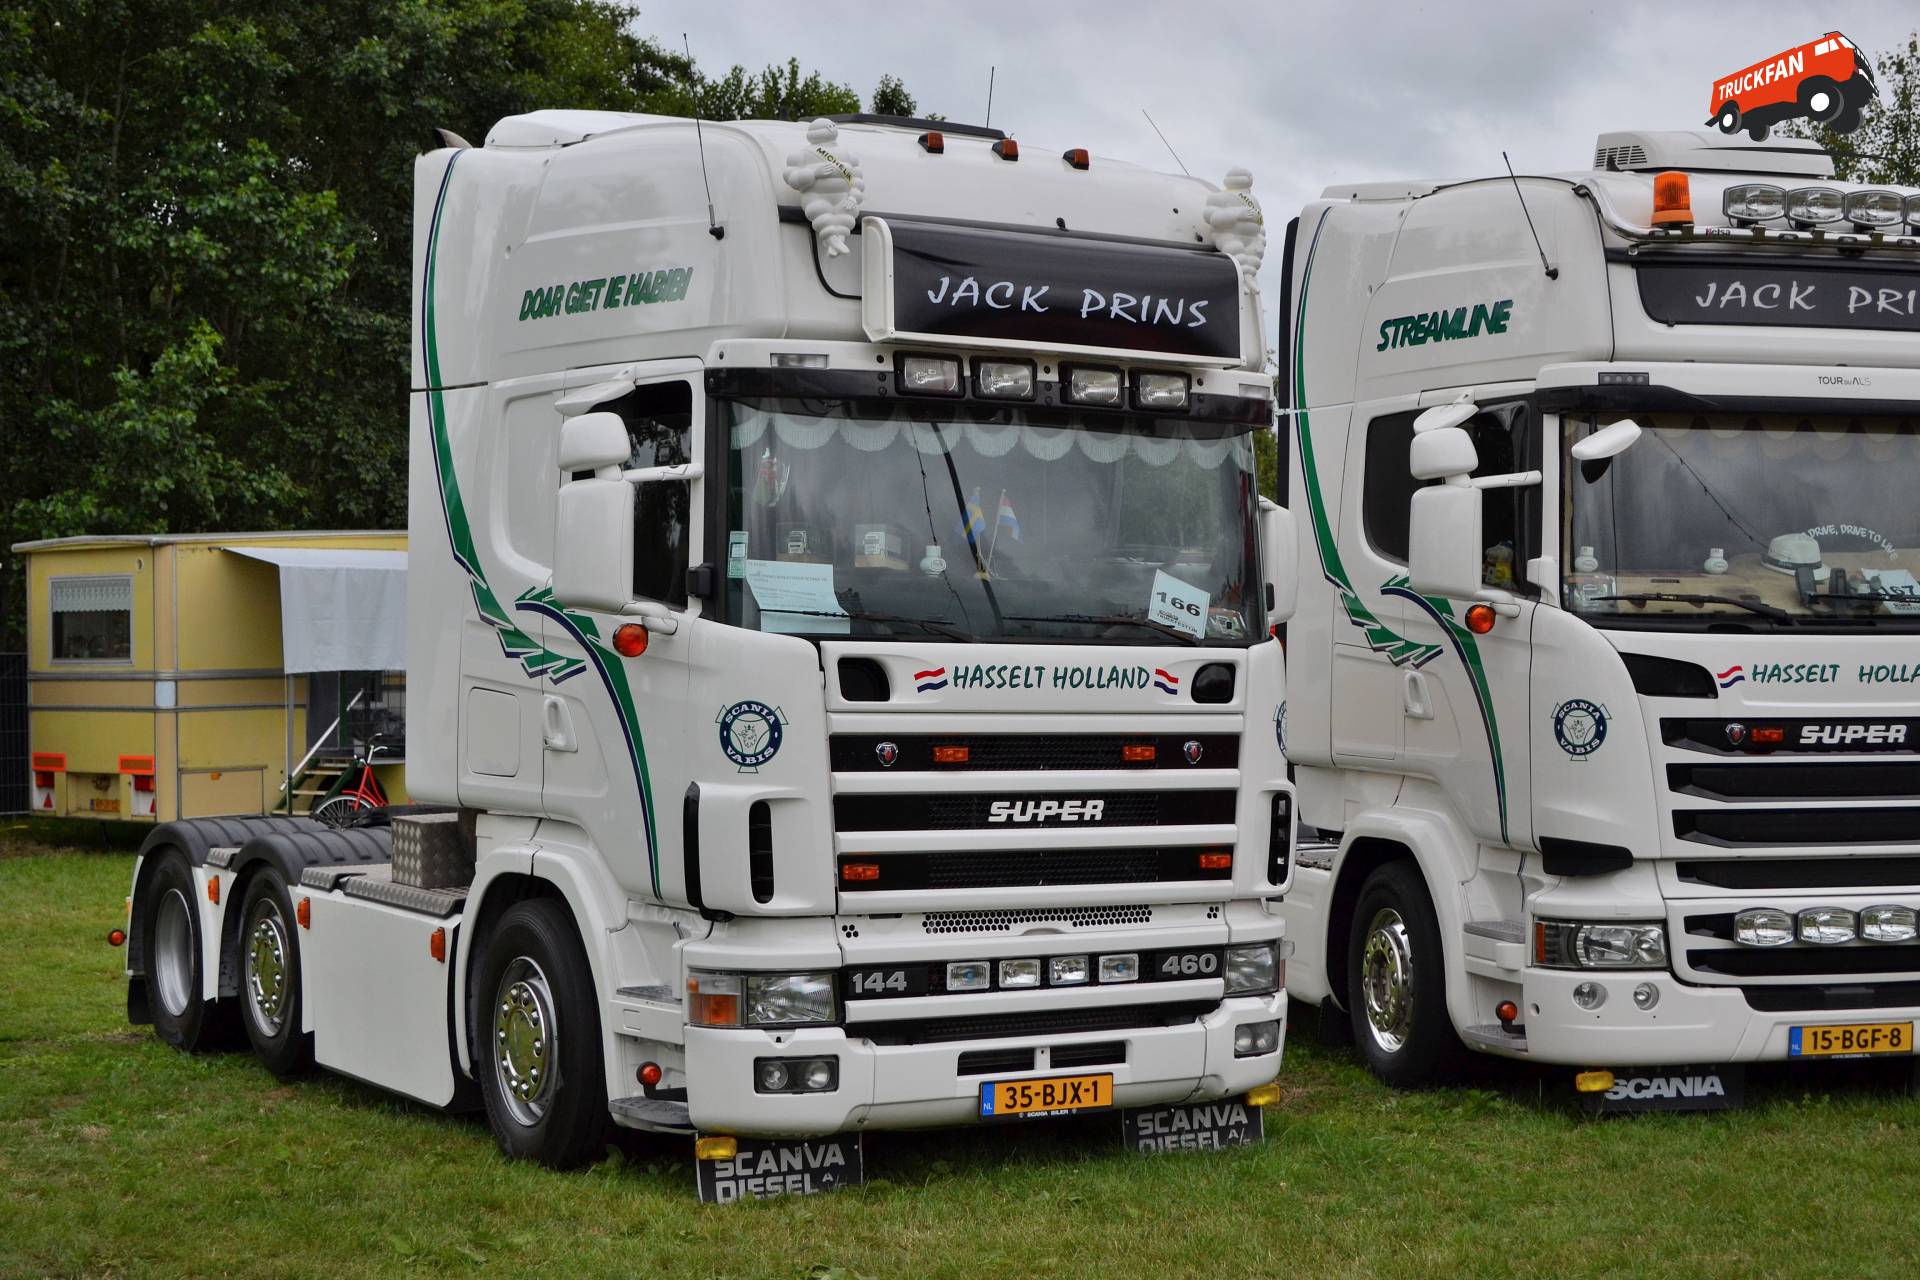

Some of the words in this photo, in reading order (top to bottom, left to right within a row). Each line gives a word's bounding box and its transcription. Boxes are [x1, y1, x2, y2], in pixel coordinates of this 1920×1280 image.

[519, 284, 565, 321] DOAR
[565, 278, 607, 315] GIET
[603, 275, 627, 309] IE
[927, 276, 1050, 312] JACK
[1080, 288, 1209, 327] PRINS
[1695, 280, 1816, 310] JACK
[1847, 286, 1916, 316] PRI
[1376, 299, 1514, 352] STREAMLINE
[1818, 376, 1843, 385] TOUR
[1840, 524, 1867, 537] DRIVE
[1868, 530, 1881, 543] TO
[1156, 591, 1201, 617] 166
[953, 664, 1045, 689] HASSELT
[1053, 666, 1150, 690] HOLLAND
[1752, 663, 1840, 684] HASSELT
[725, 703, 775, 724] SCANIA
[1558, 702, 1600, 720] SCANIA
[1560, 738, 1600, 753] VABIS
[1800, 724, 1907, 744] SUPER
[727, 745, 774, 764] VABIS
[987, 799, 1105, 822] SUPER
[1161, 954, 1217, 975] 460
[852, 970, 907, 994] 144
[1812, 1027, 1902, 1051] 15-BGF-8
[1005, 1080, 1098, 1109] 35-BJX-1
[1604, 1075, 1725, 1100] SCANIA
[983, 1102, 993, 1110] NL
[1136, 1103, 1248, 1136] SCANVA
[715, 1143, 846, 1178] SCANVA
[715, 1173, 819, 1204] DIESEL
